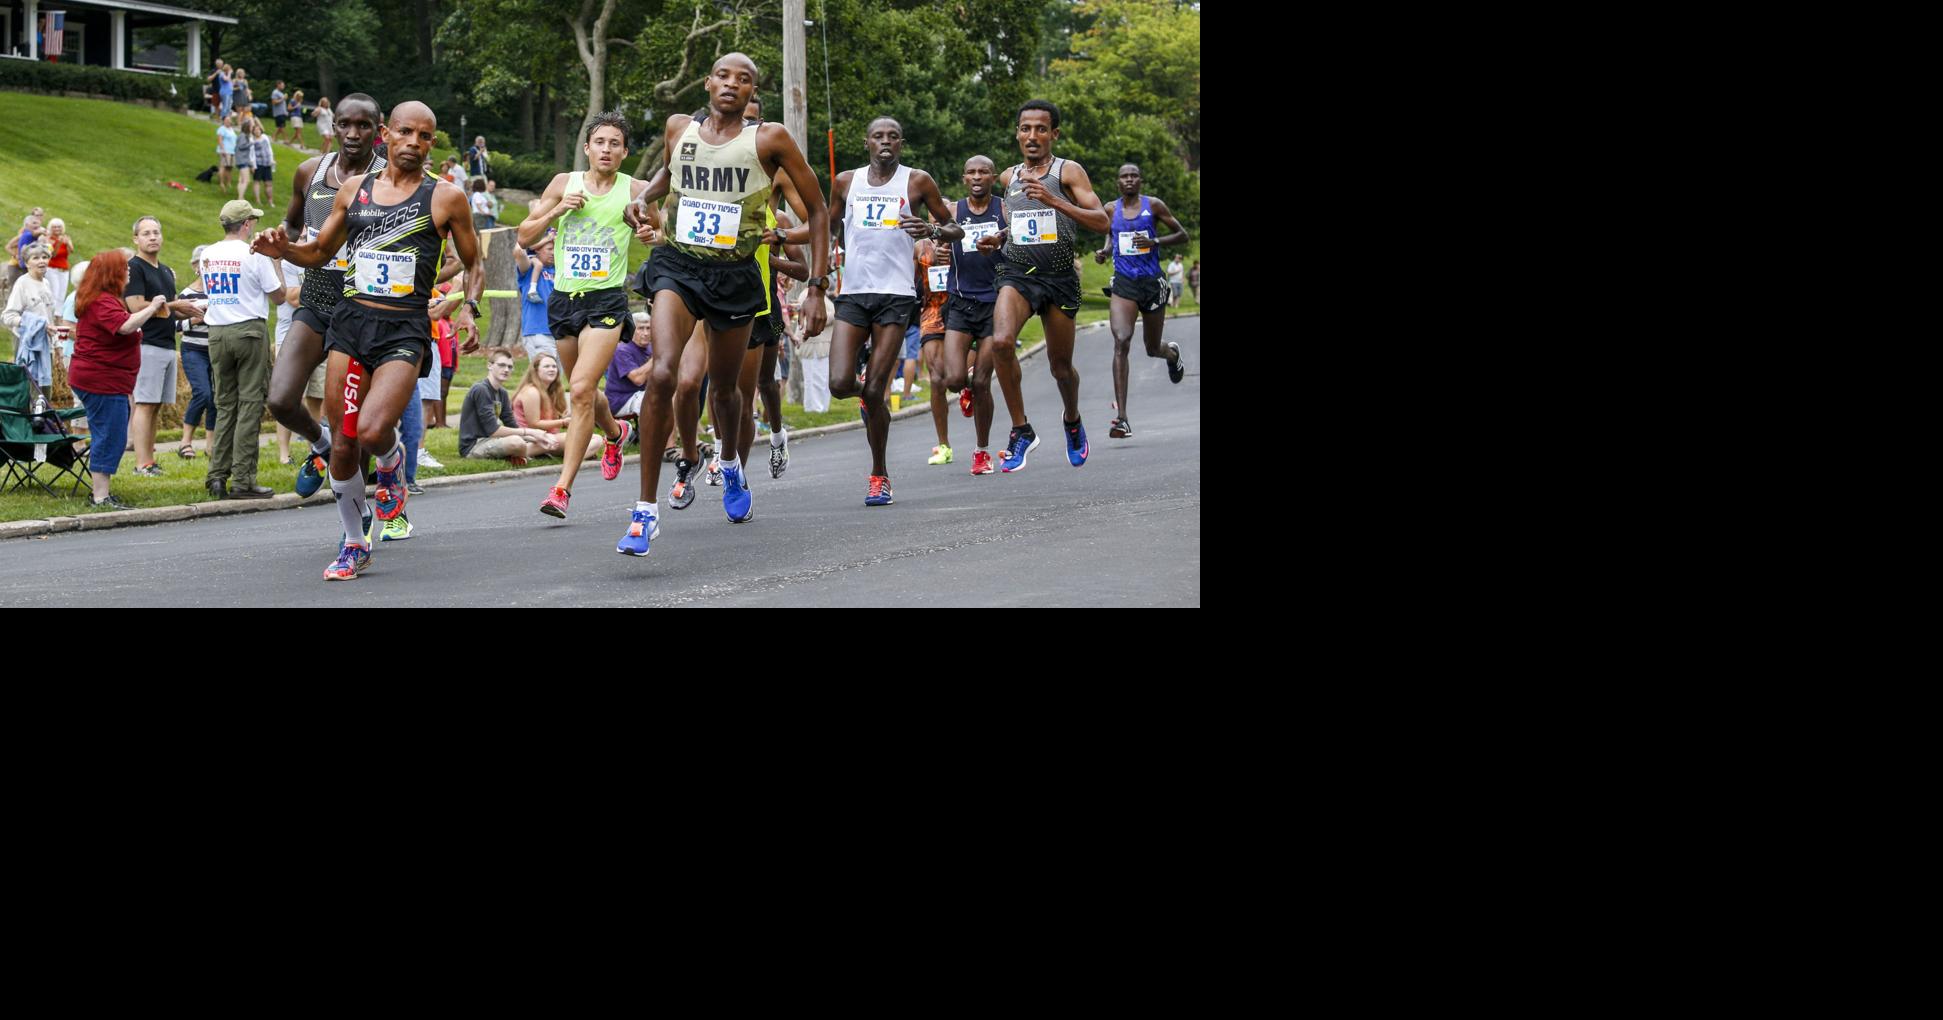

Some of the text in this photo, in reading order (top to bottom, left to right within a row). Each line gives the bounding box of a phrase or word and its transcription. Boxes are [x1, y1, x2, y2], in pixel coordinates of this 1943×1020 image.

[681, 165, 750, 193] ARMY
[682, 199, 739, 214] QUAD CITY TIMES
[866, 203, 886, 220] 17
[692, 211, 721, 236] 33
[1028, 219, 1037, 236] 9
[377, 253, 390, 261] CITY
[392, 254, 413, 263] TIMES
[571, 253, 601, 271] 283
[377, 263, 389, 285] 3
[344, 373, 361, 415] USA
